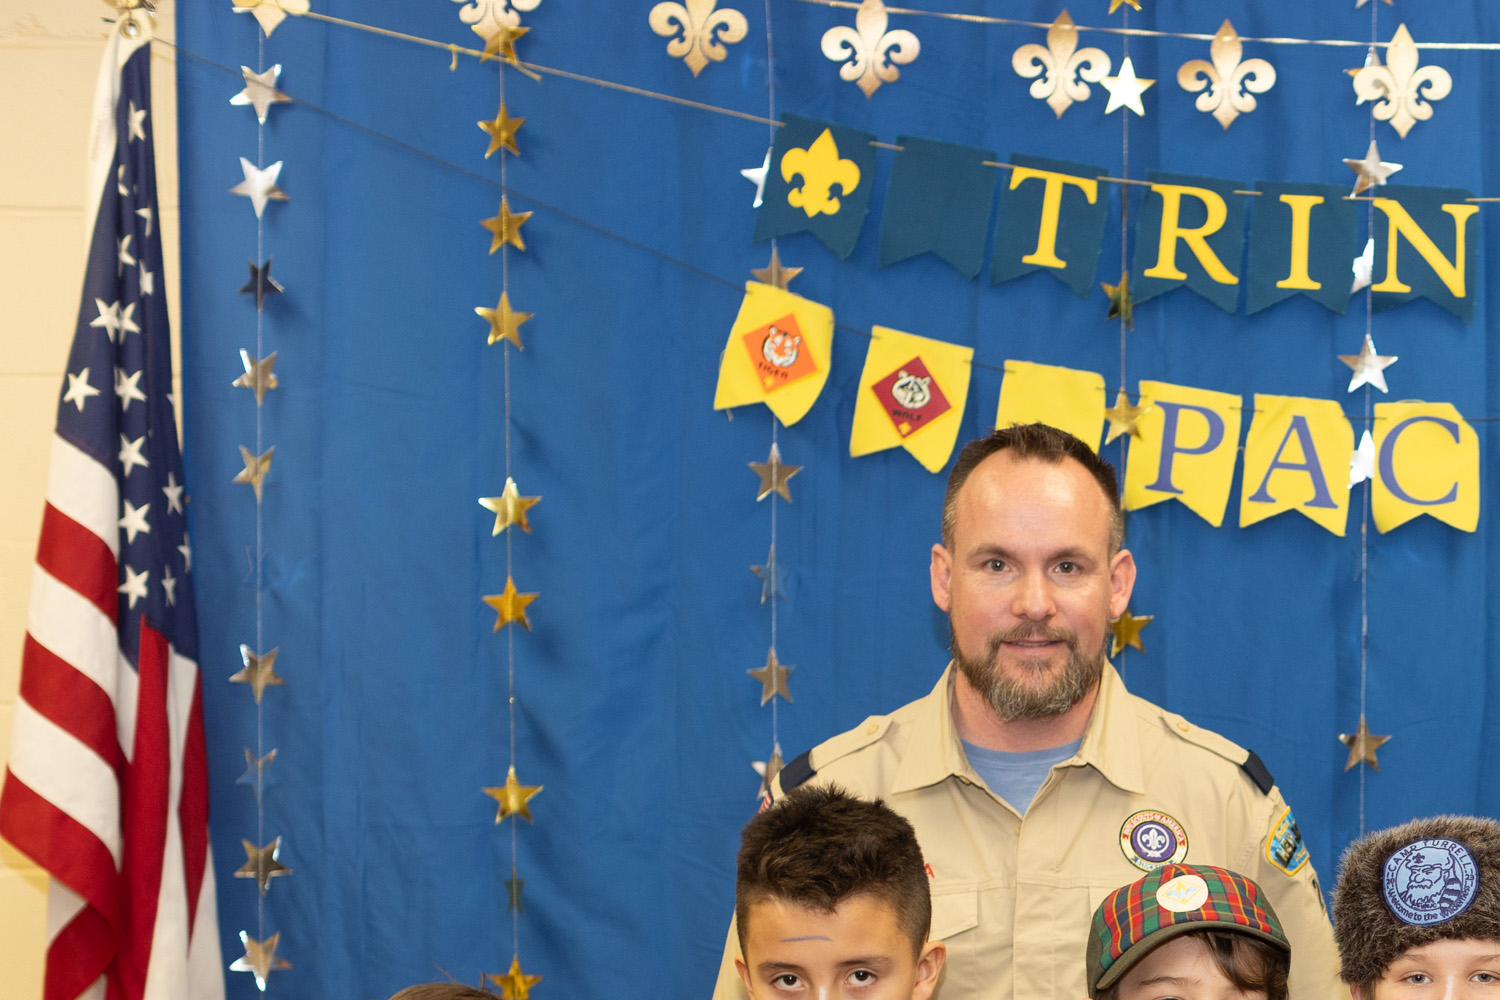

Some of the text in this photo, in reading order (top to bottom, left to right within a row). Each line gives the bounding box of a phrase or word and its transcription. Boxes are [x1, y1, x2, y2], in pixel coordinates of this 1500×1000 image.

[892, 408, 923, 423] WOLF
[1388, 840, 1472, 872] CAMP TURRELL
